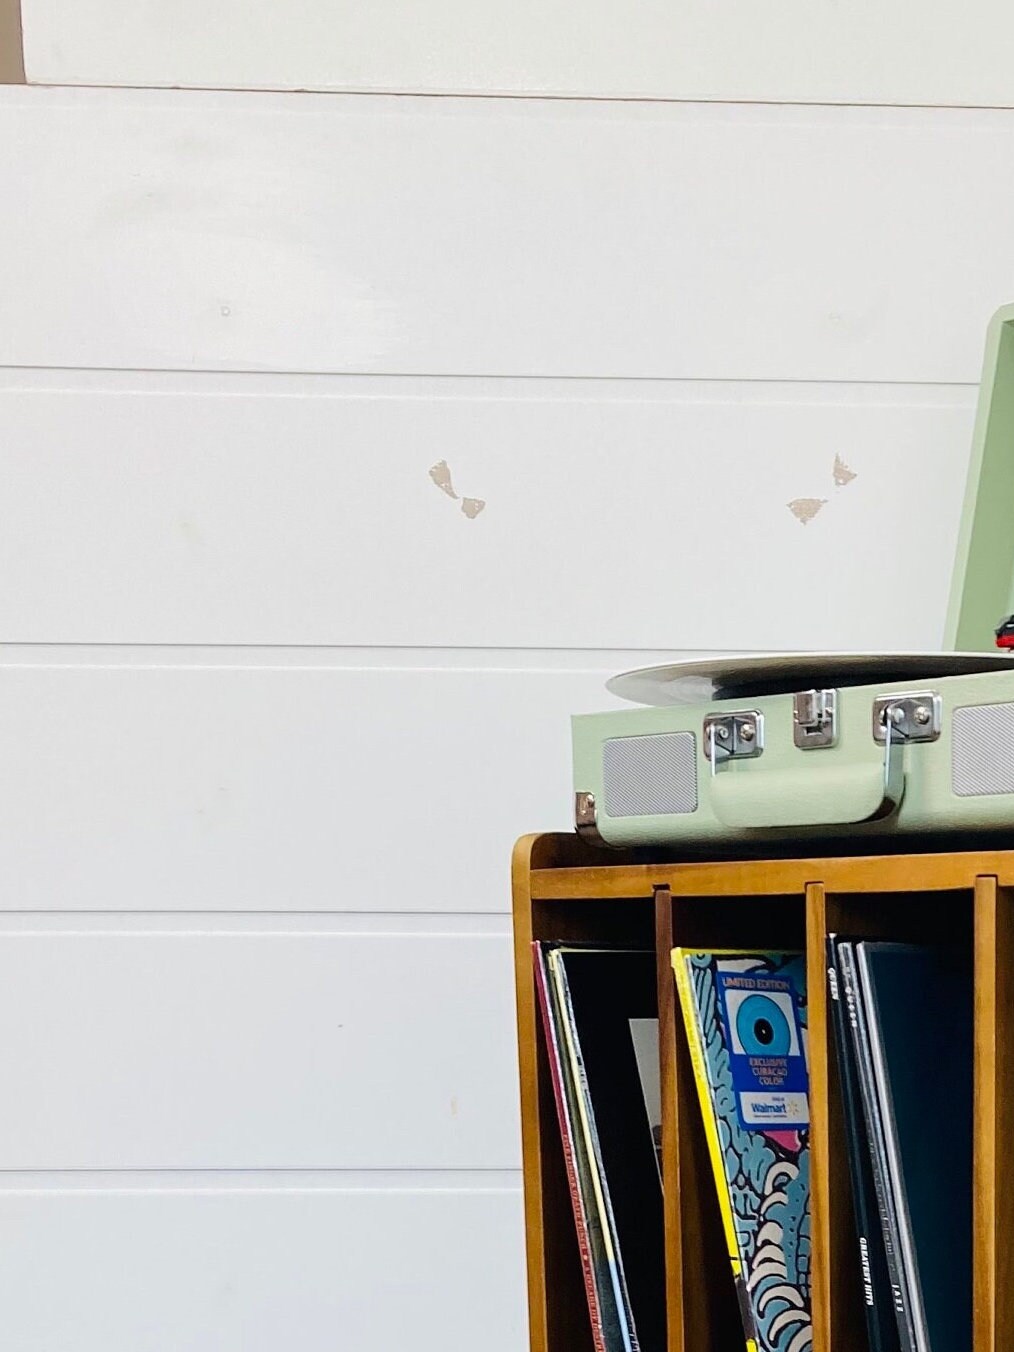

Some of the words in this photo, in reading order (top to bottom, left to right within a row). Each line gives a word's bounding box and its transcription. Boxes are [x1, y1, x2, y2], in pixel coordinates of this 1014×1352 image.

[722, 977, 755, 989] LIMITED
[757, 979, 790, 990] EDITION
[827, 967, 840, 1000] QUEEN
[751, 1102, 787, 1114] Walmart
[859, 1237, 872, 1283] GREATEST
[864, 1283, 874, 1306] HITS
